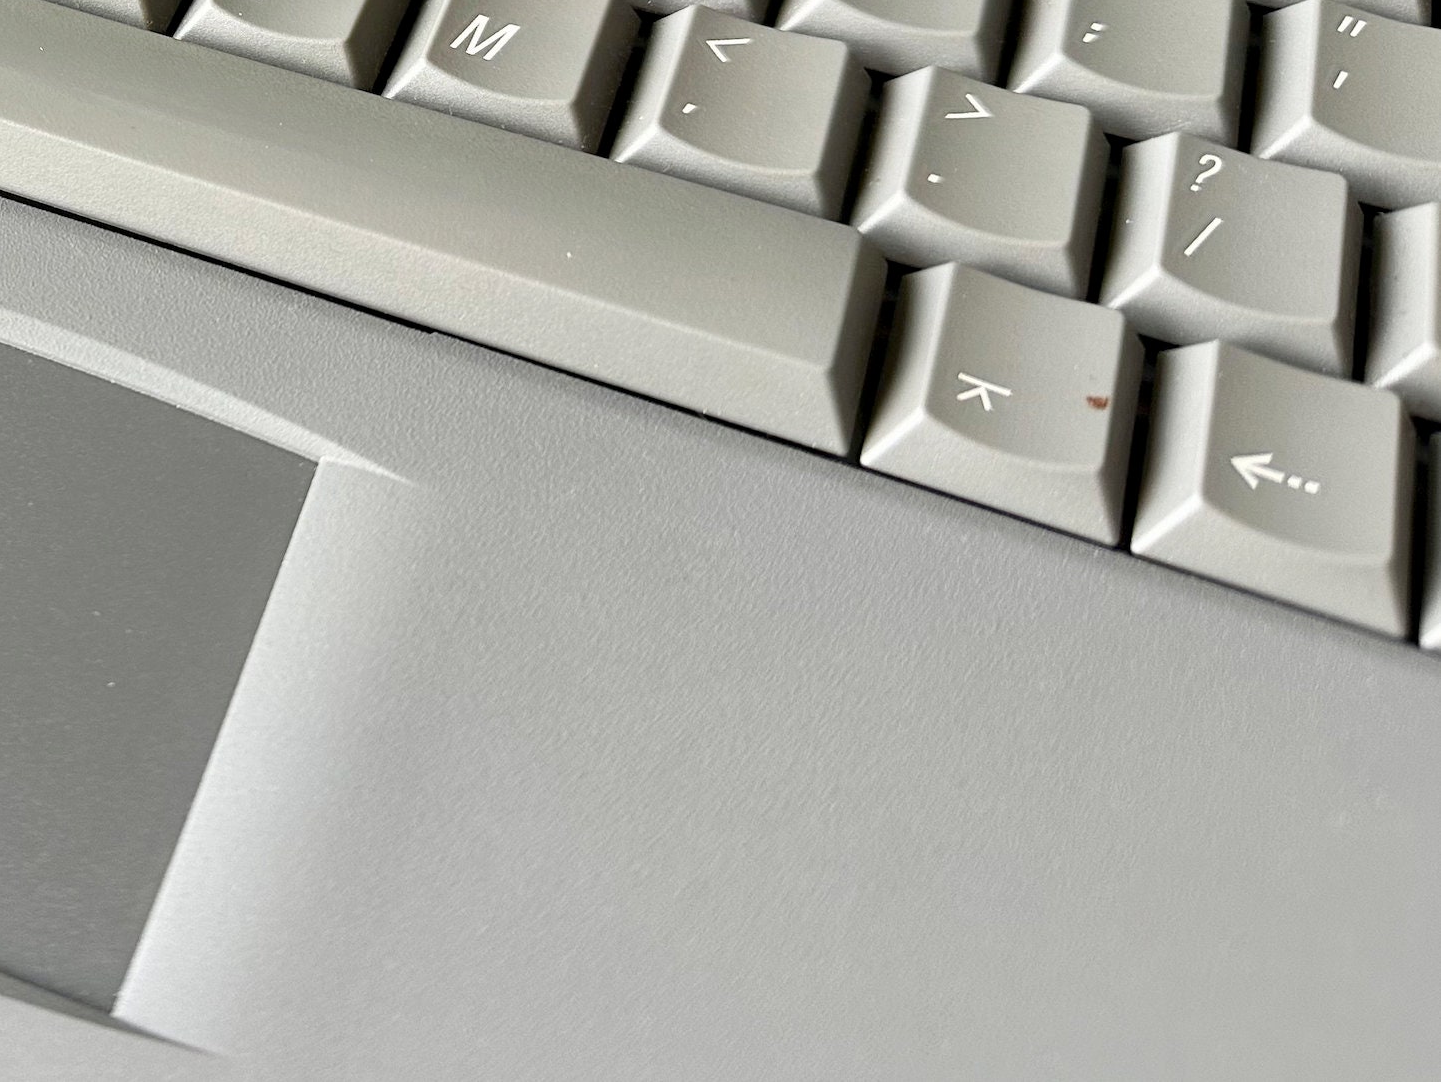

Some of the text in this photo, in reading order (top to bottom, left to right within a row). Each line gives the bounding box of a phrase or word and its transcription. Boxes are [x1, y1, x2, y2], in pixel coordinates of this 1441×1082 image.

[450, 13, 521, 61] M
[1082, 22, 1107, 44] ;
[705, 38, 754, 63] <
[944, 93, 994, 119] >
[1190, 153, 1223, 192] ?
[1184, 217, 1223, 257] /
